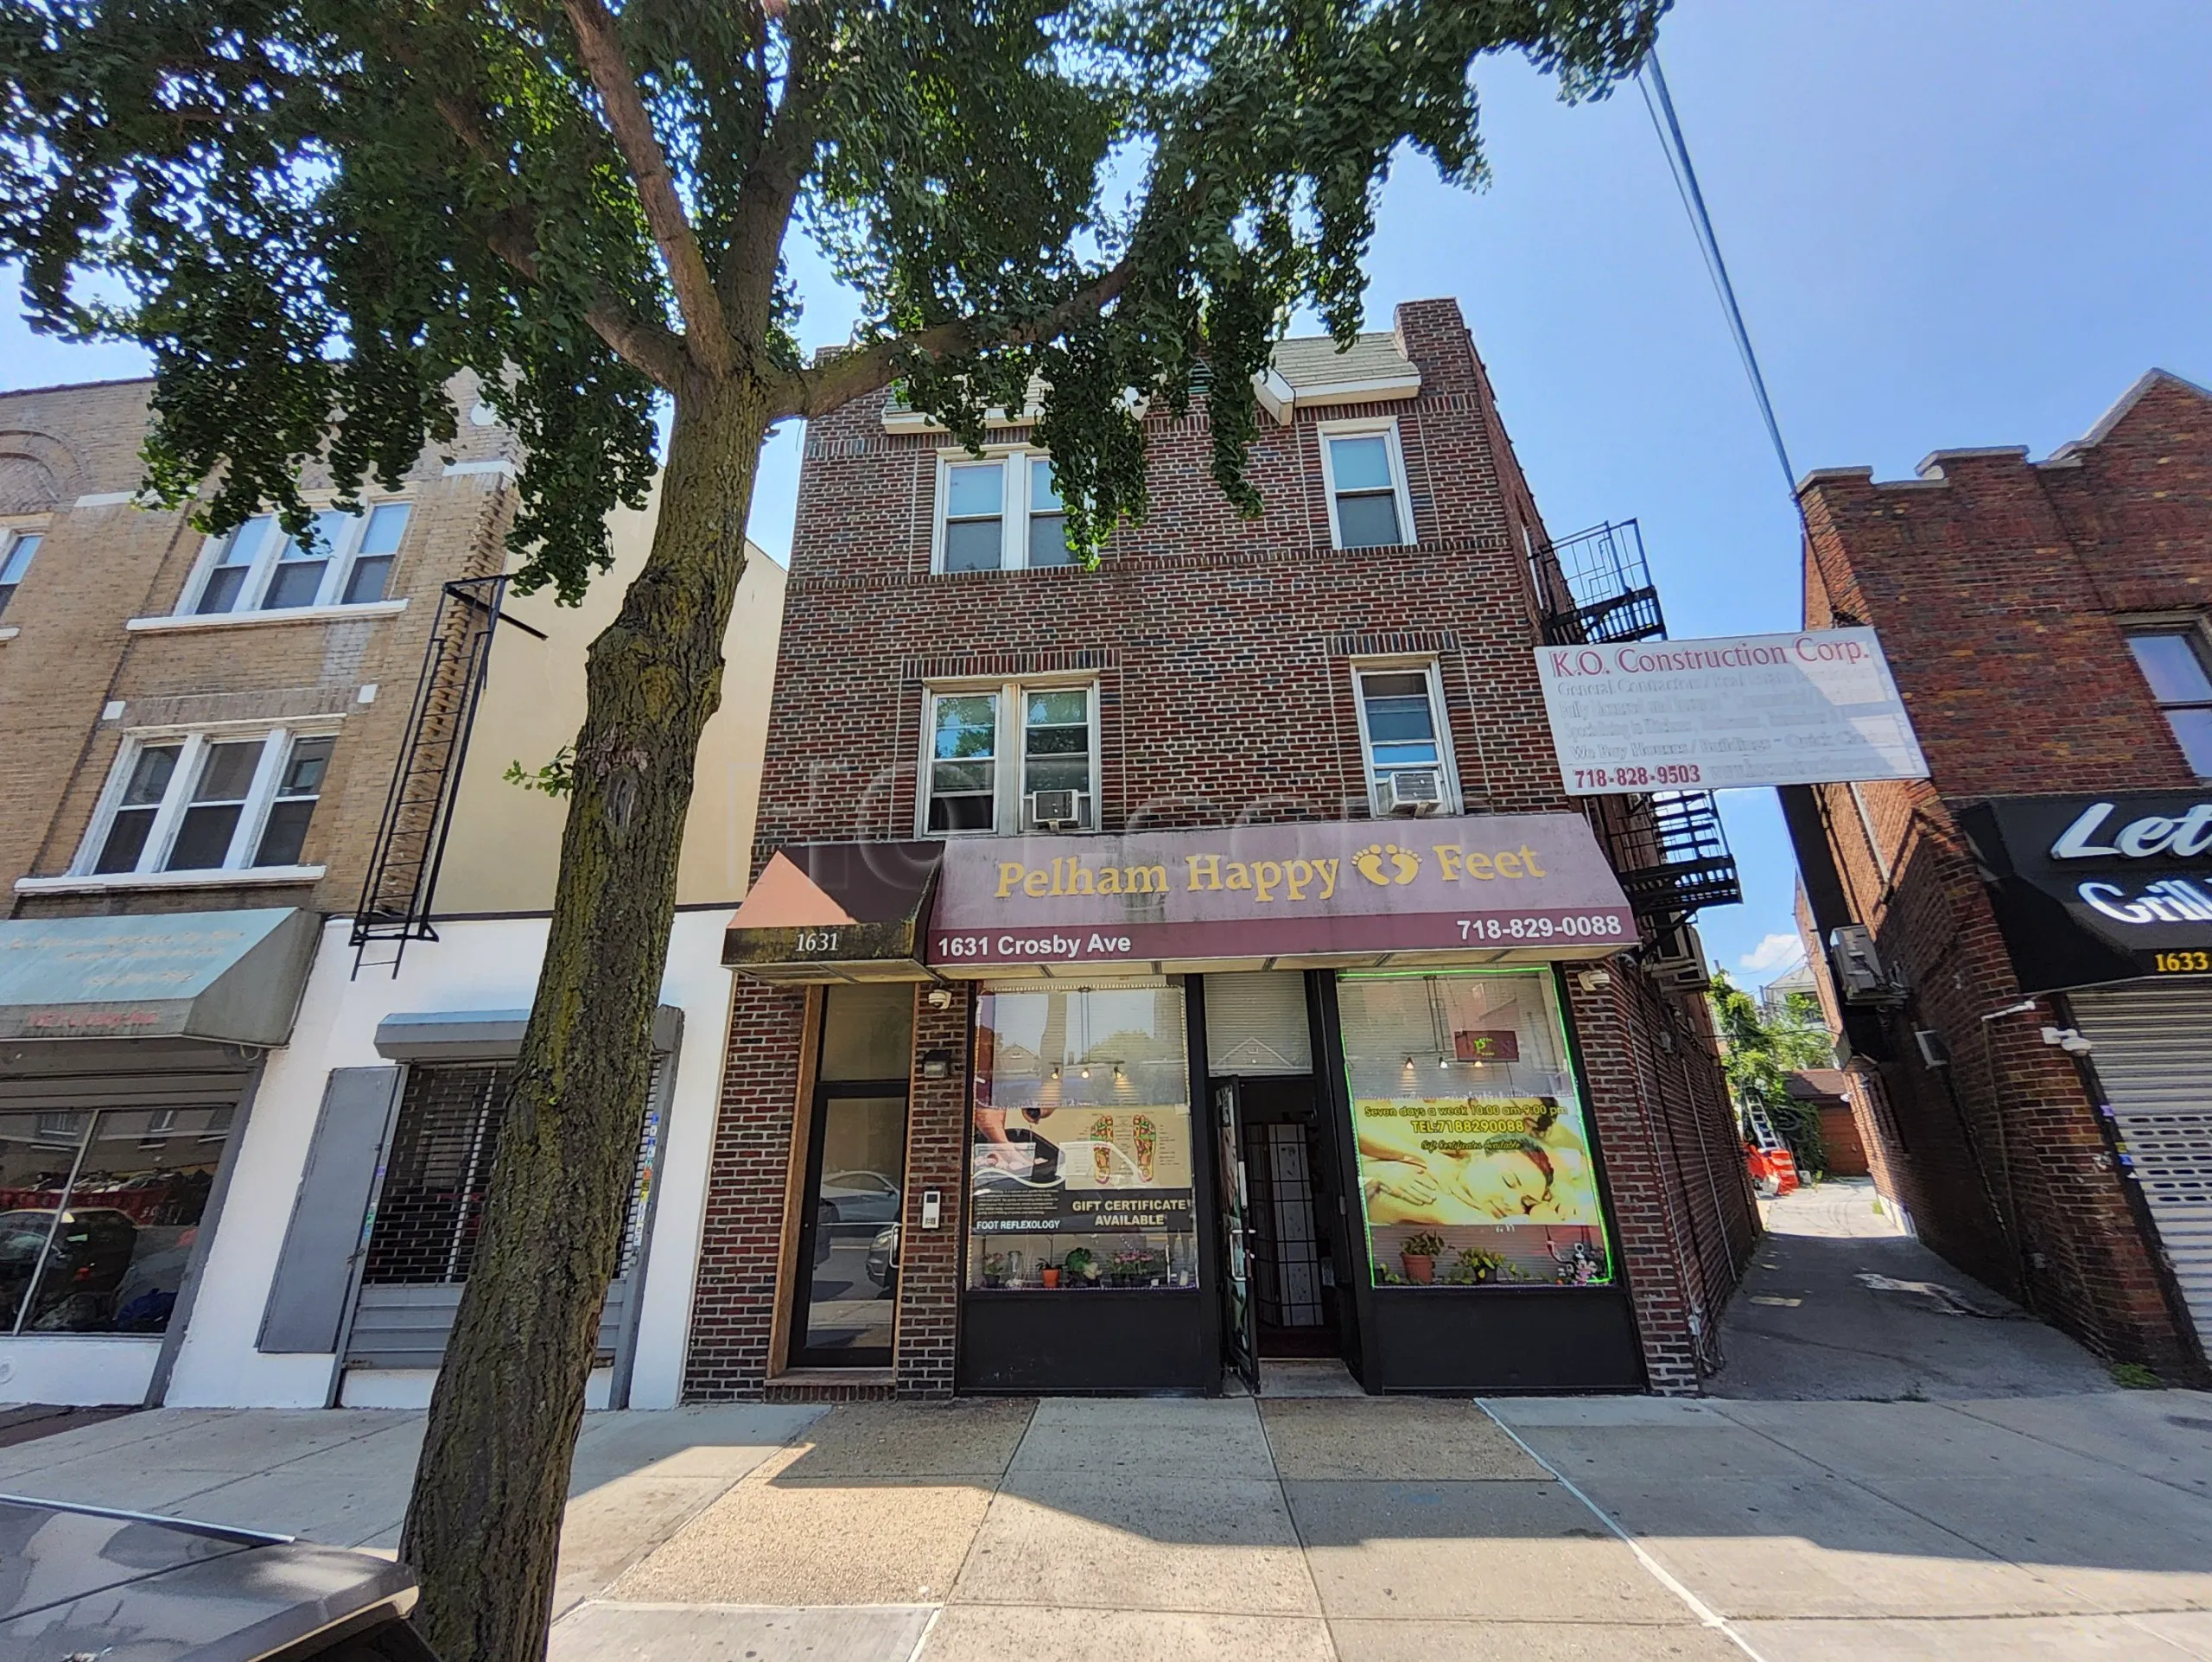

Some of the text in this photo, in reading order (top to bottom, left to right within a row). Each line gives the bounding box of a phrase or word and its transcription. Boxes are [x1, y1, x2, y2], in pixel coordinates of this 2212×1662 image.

[1550, 637, 1870, 678] K.O. Construction Corp.
[1574, 764, 1700, 788] 718-828-9503
[995, 844, 1547, 902] Pelham Happy Feet
[1457, 915, 1622, 940] 718-829-0088
[795, 932, 839, 952] 1631
[938, 931, 1132, 959] 1631 Crosby Ave
[2155, 952, 2209, 971] 1633
[1364, 1106, 1397, 1117] Seven
[1399, 1105, 1426, 1118] days
[1427, 1106, 1436, 1116] a
[1438, 1105, 1469, 1116] week
[1411, 1120, 1524, 1133] TEL:7188290088
[1072, 1200, 1186, 1211] GIFT CERTIFICATE
[976, 1219, 1061, 1230] FOOT REFLEXOLOGY
[1095, 1214, 1165, 1226] AVAILABLE
